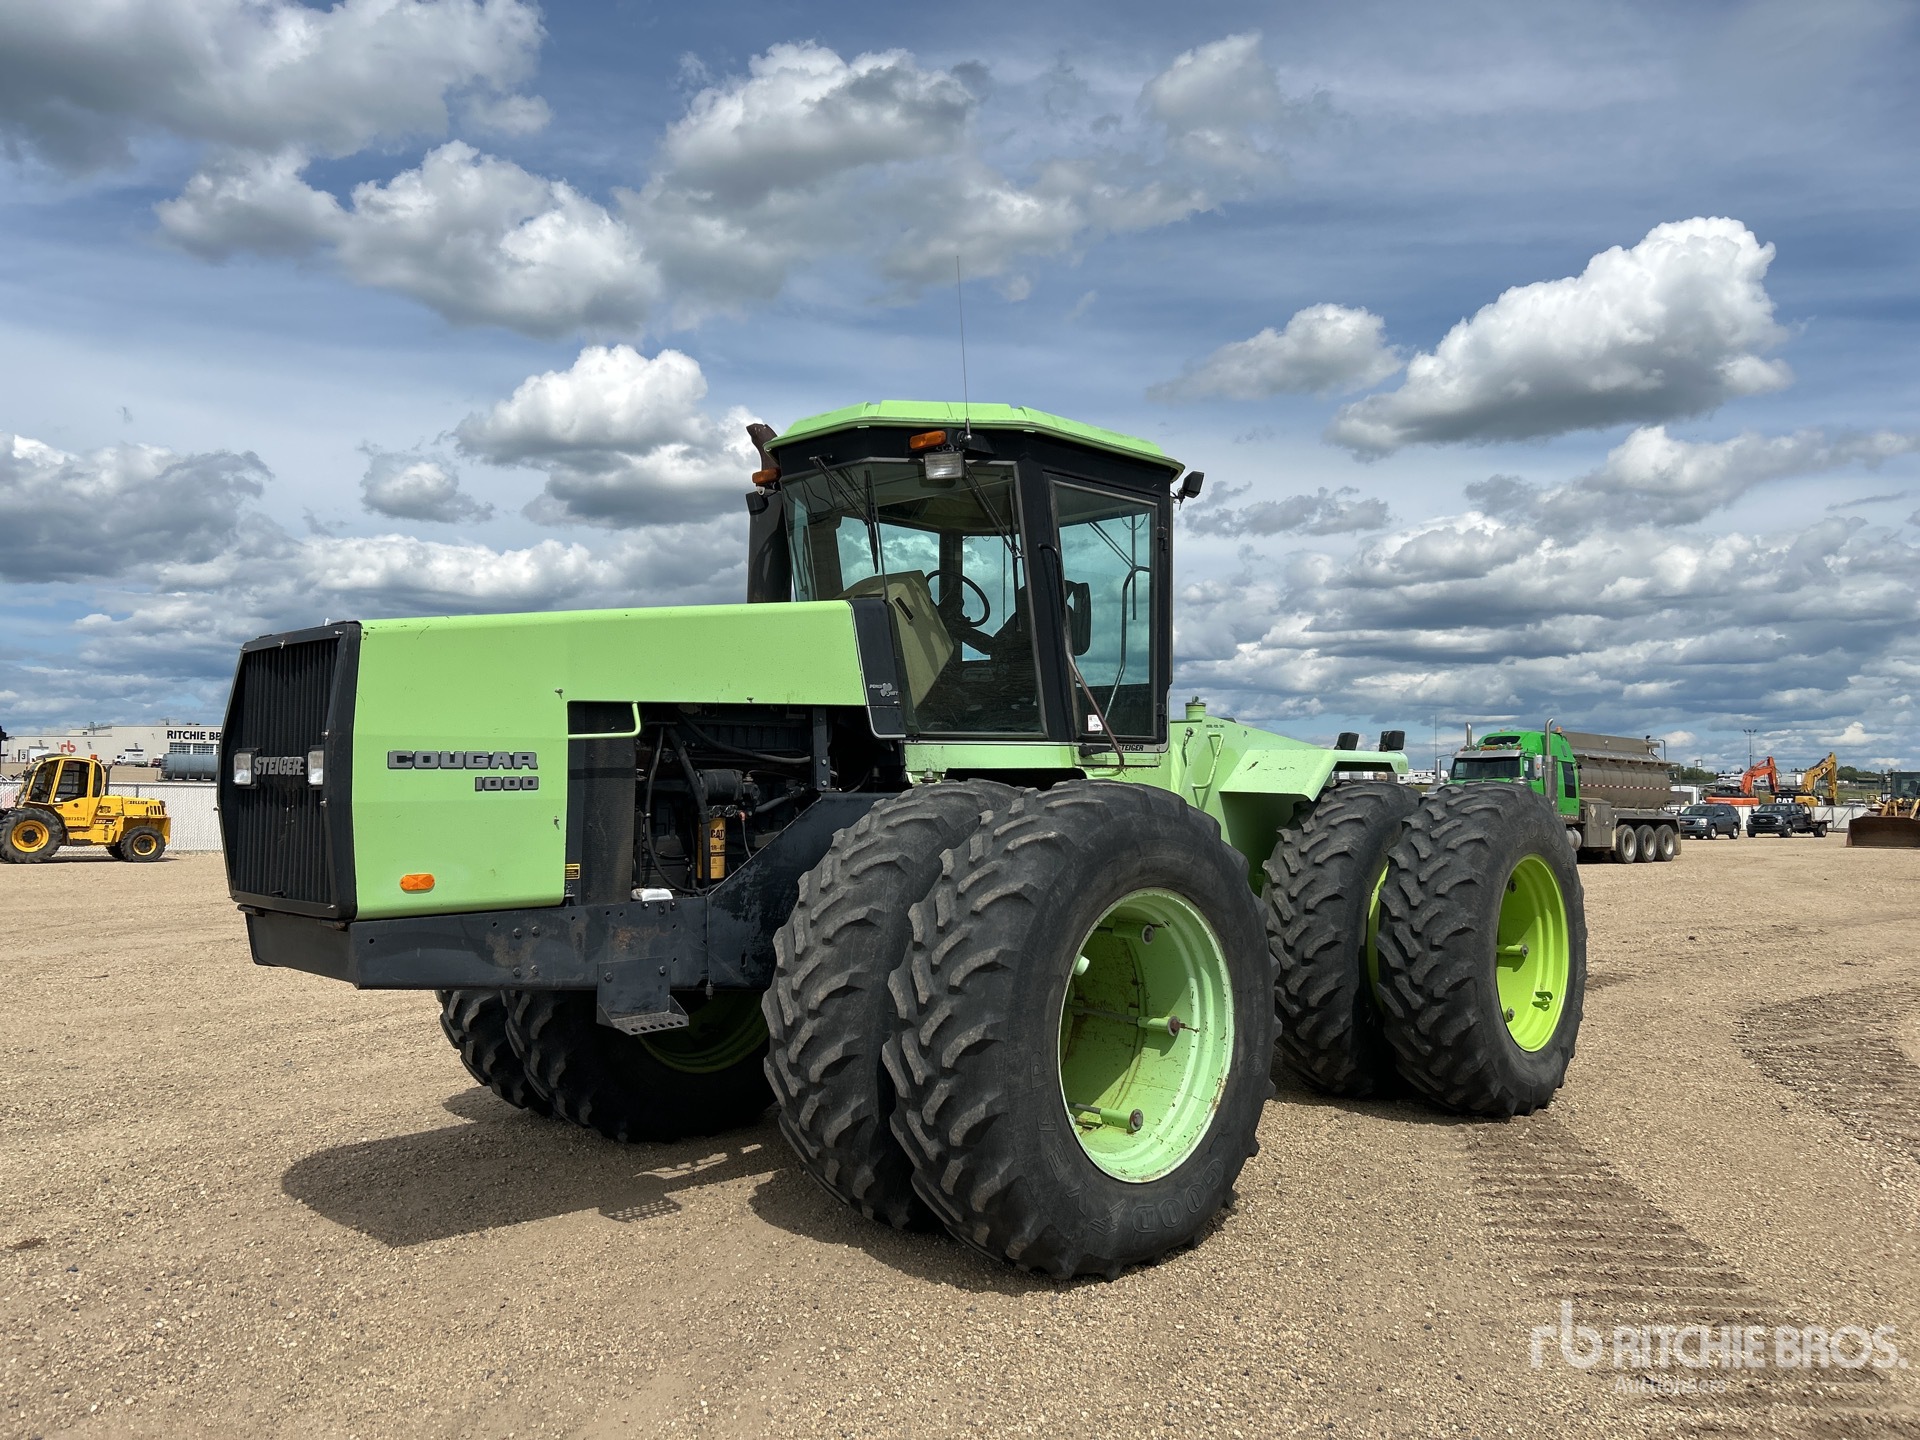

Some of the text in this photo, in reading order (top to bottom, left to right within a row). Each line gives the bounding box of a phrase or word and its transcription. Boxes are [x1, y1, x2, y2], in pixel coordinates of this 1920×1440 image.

[166, 730, 206, 740] RITCHIE
[61, 740, 76, 753] rb
[254, 756, 305, 776] STEIGER
[387, 750, 539, 770] COUGAR
[474, 776, 539, 792] 1000
[711, 829, 725, 840] CAT
